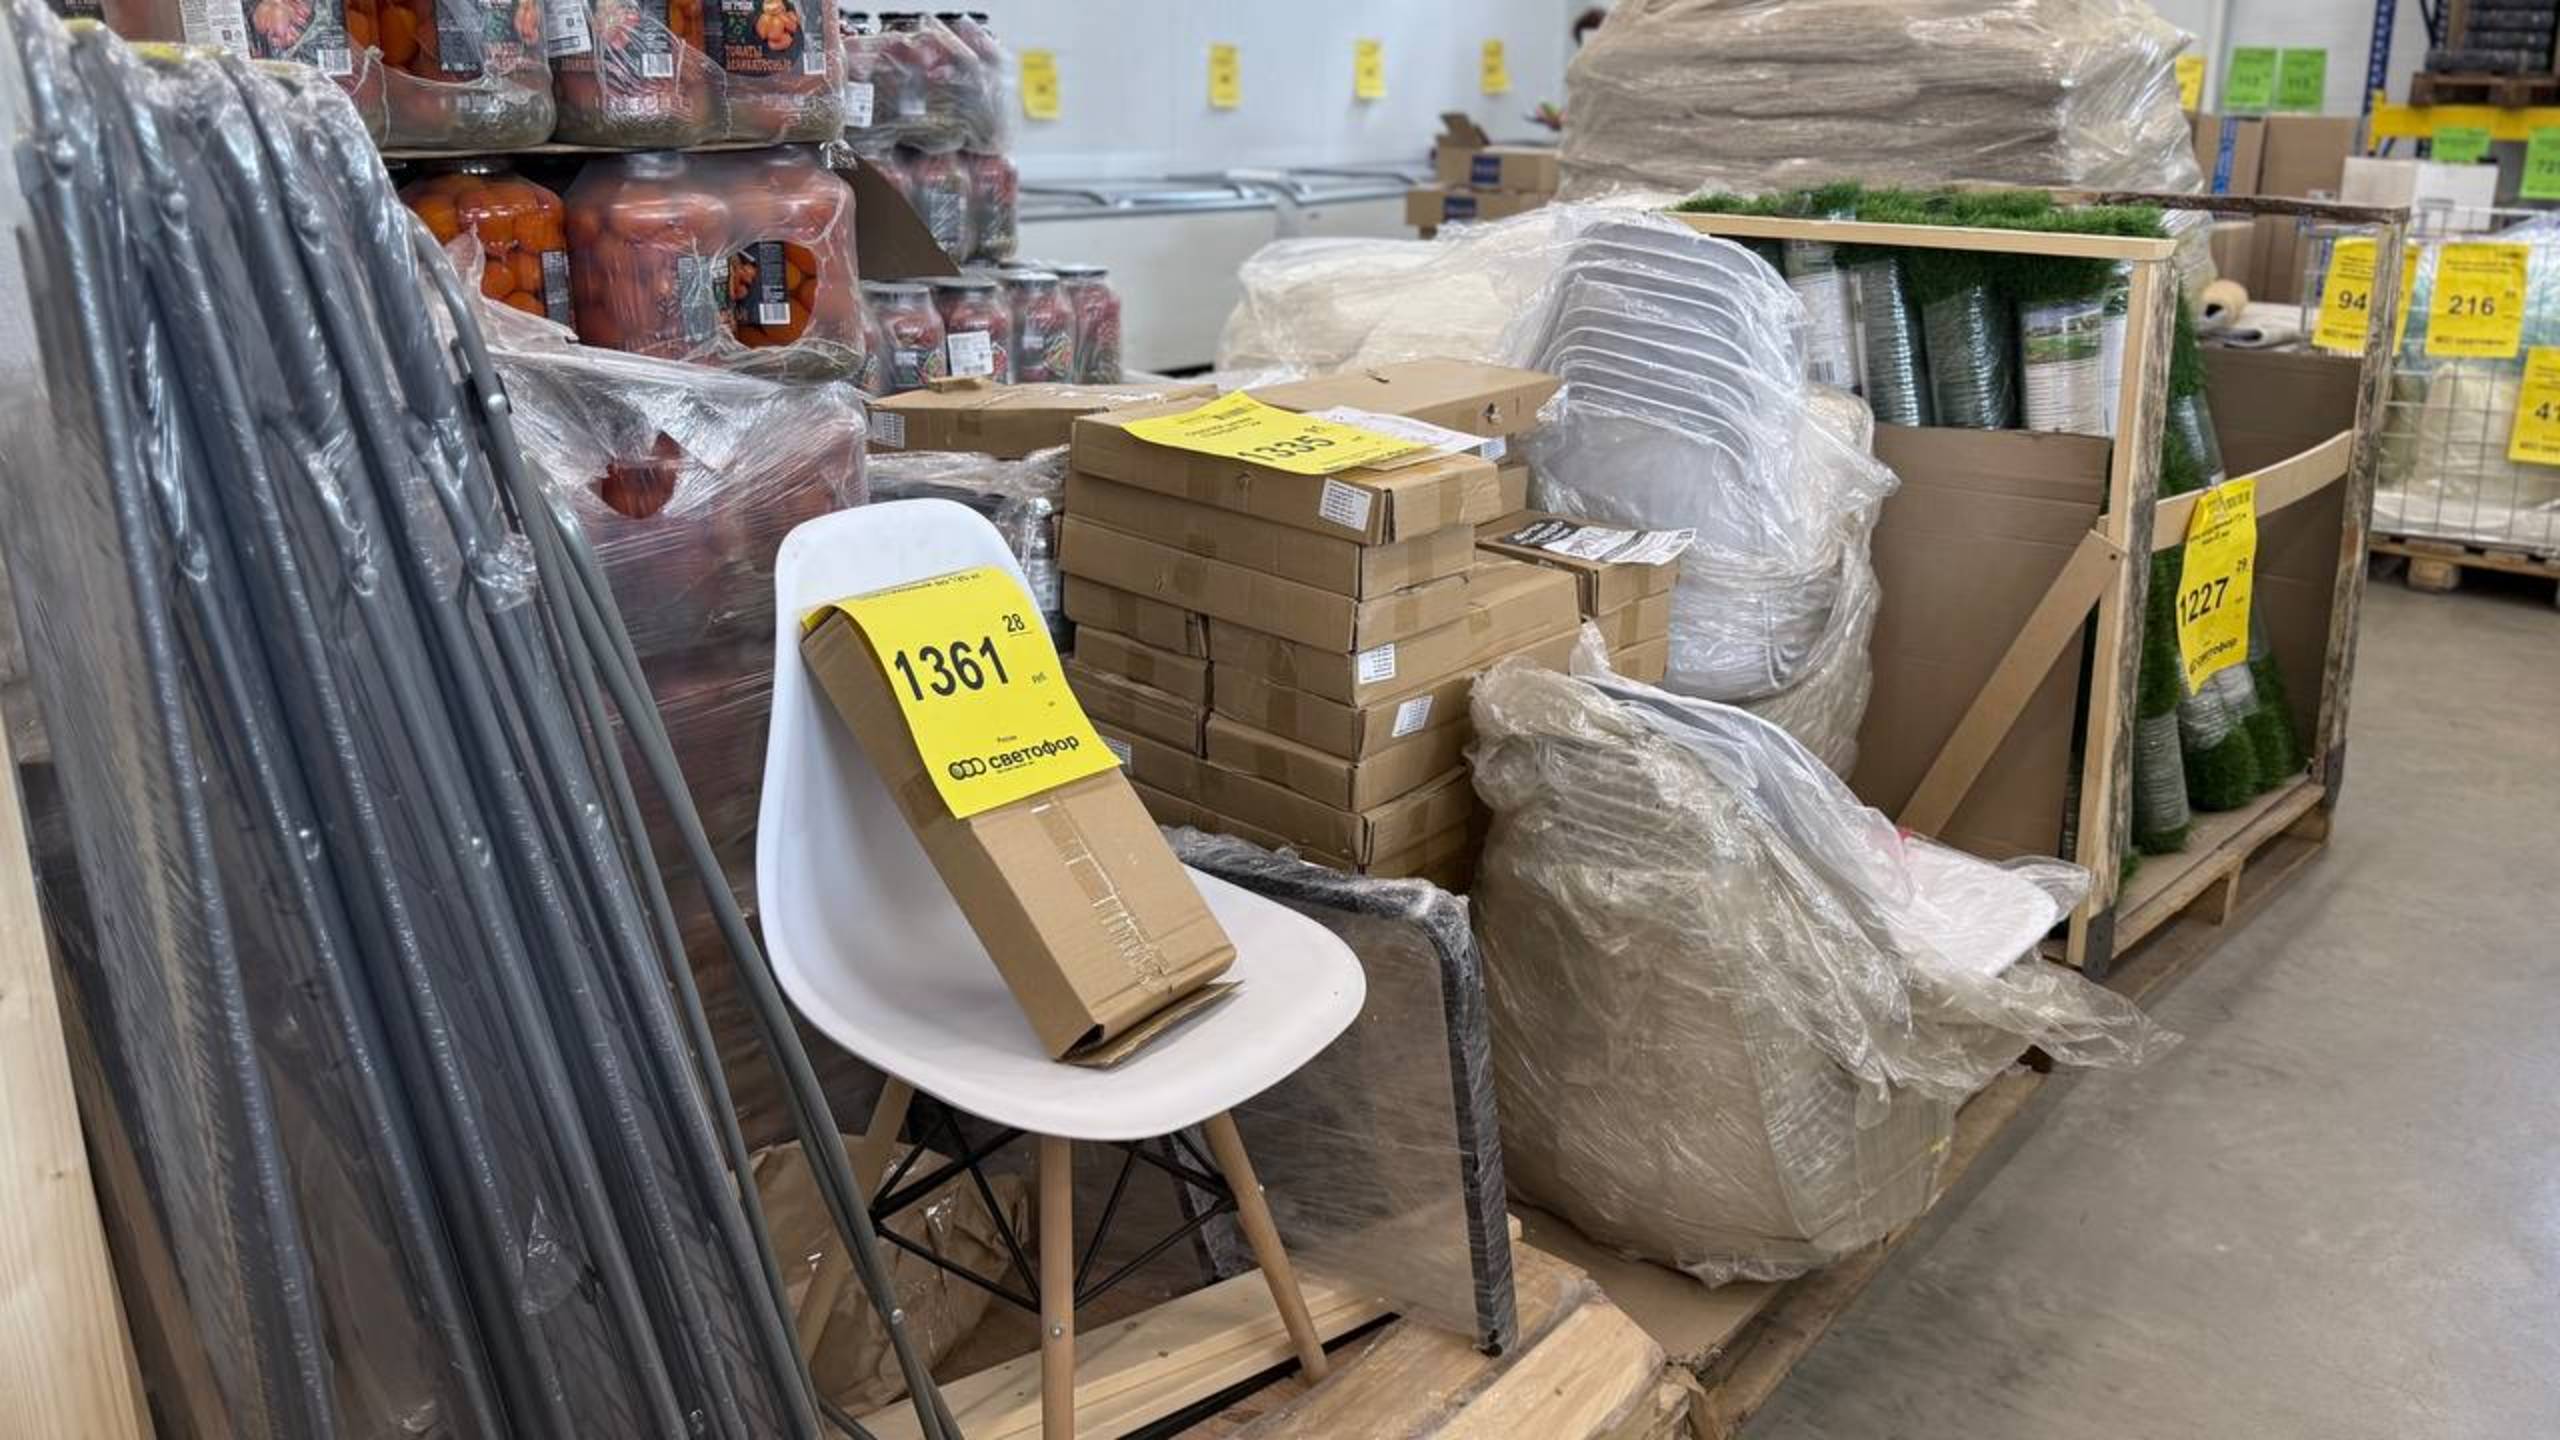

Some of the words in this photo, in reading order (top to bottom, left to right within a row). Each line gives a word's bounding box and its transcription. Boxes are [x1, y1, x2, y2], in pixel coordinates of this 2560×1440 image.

[2447, 294, 2495, 317] 216
[1236, 434, 1336, 463] 1335
[2179, 576, 2230, 628] 1227
[1001, 612, 1025, 633] 28
[894, 635, 1009, 702] 1361
[988, 735, 1080, 770] светофор
